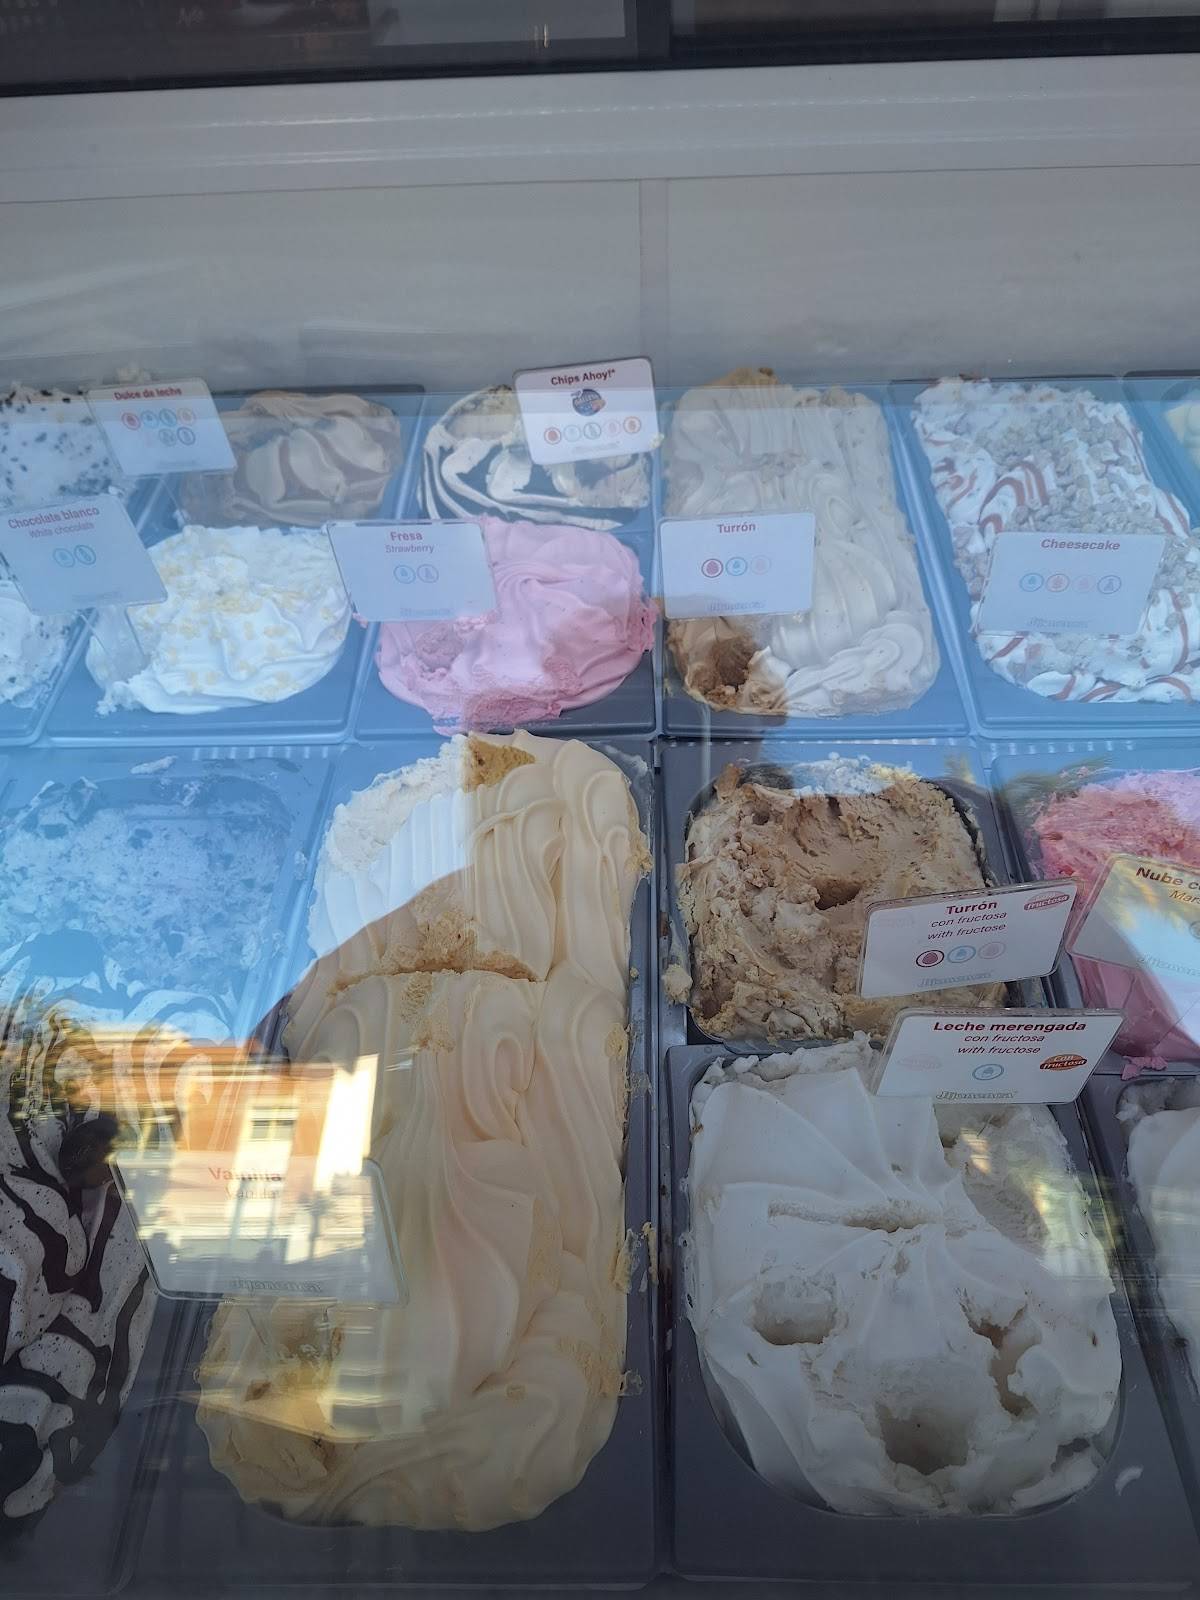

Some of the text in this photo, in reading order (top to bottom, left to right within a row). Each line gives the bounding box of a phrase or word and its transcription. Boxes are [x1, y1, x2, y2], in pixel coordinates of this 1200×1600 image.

[551, 376, 580, 386] Chips
[113, 387, 183, 401] Dulce de leche
[8, 506, 100, 529] Chocolate blanco
[28, 520, 95, 538] White chocolate
[717, 522, 756, 534] Turrón
[390, 531, 423, 541] Fresa
[385, 544, 434, 554] Strawberry
[1041, 538, 1121, 551] Cheesecake
[1136, 867, 1184, 886] Nube
[946, 900, 998, 915] Turrón
[1027, 894, 1069, 910] fructosa
[931, 911, 1007, 928] con fructosa
[927, 923, 1006, 940] with fructose
[933, 1021, 1087, 1033] Leche merengada
[964, 1033, 1045, 1043] con fructosa
[957, 1045, 1041, 1054] with fructose
